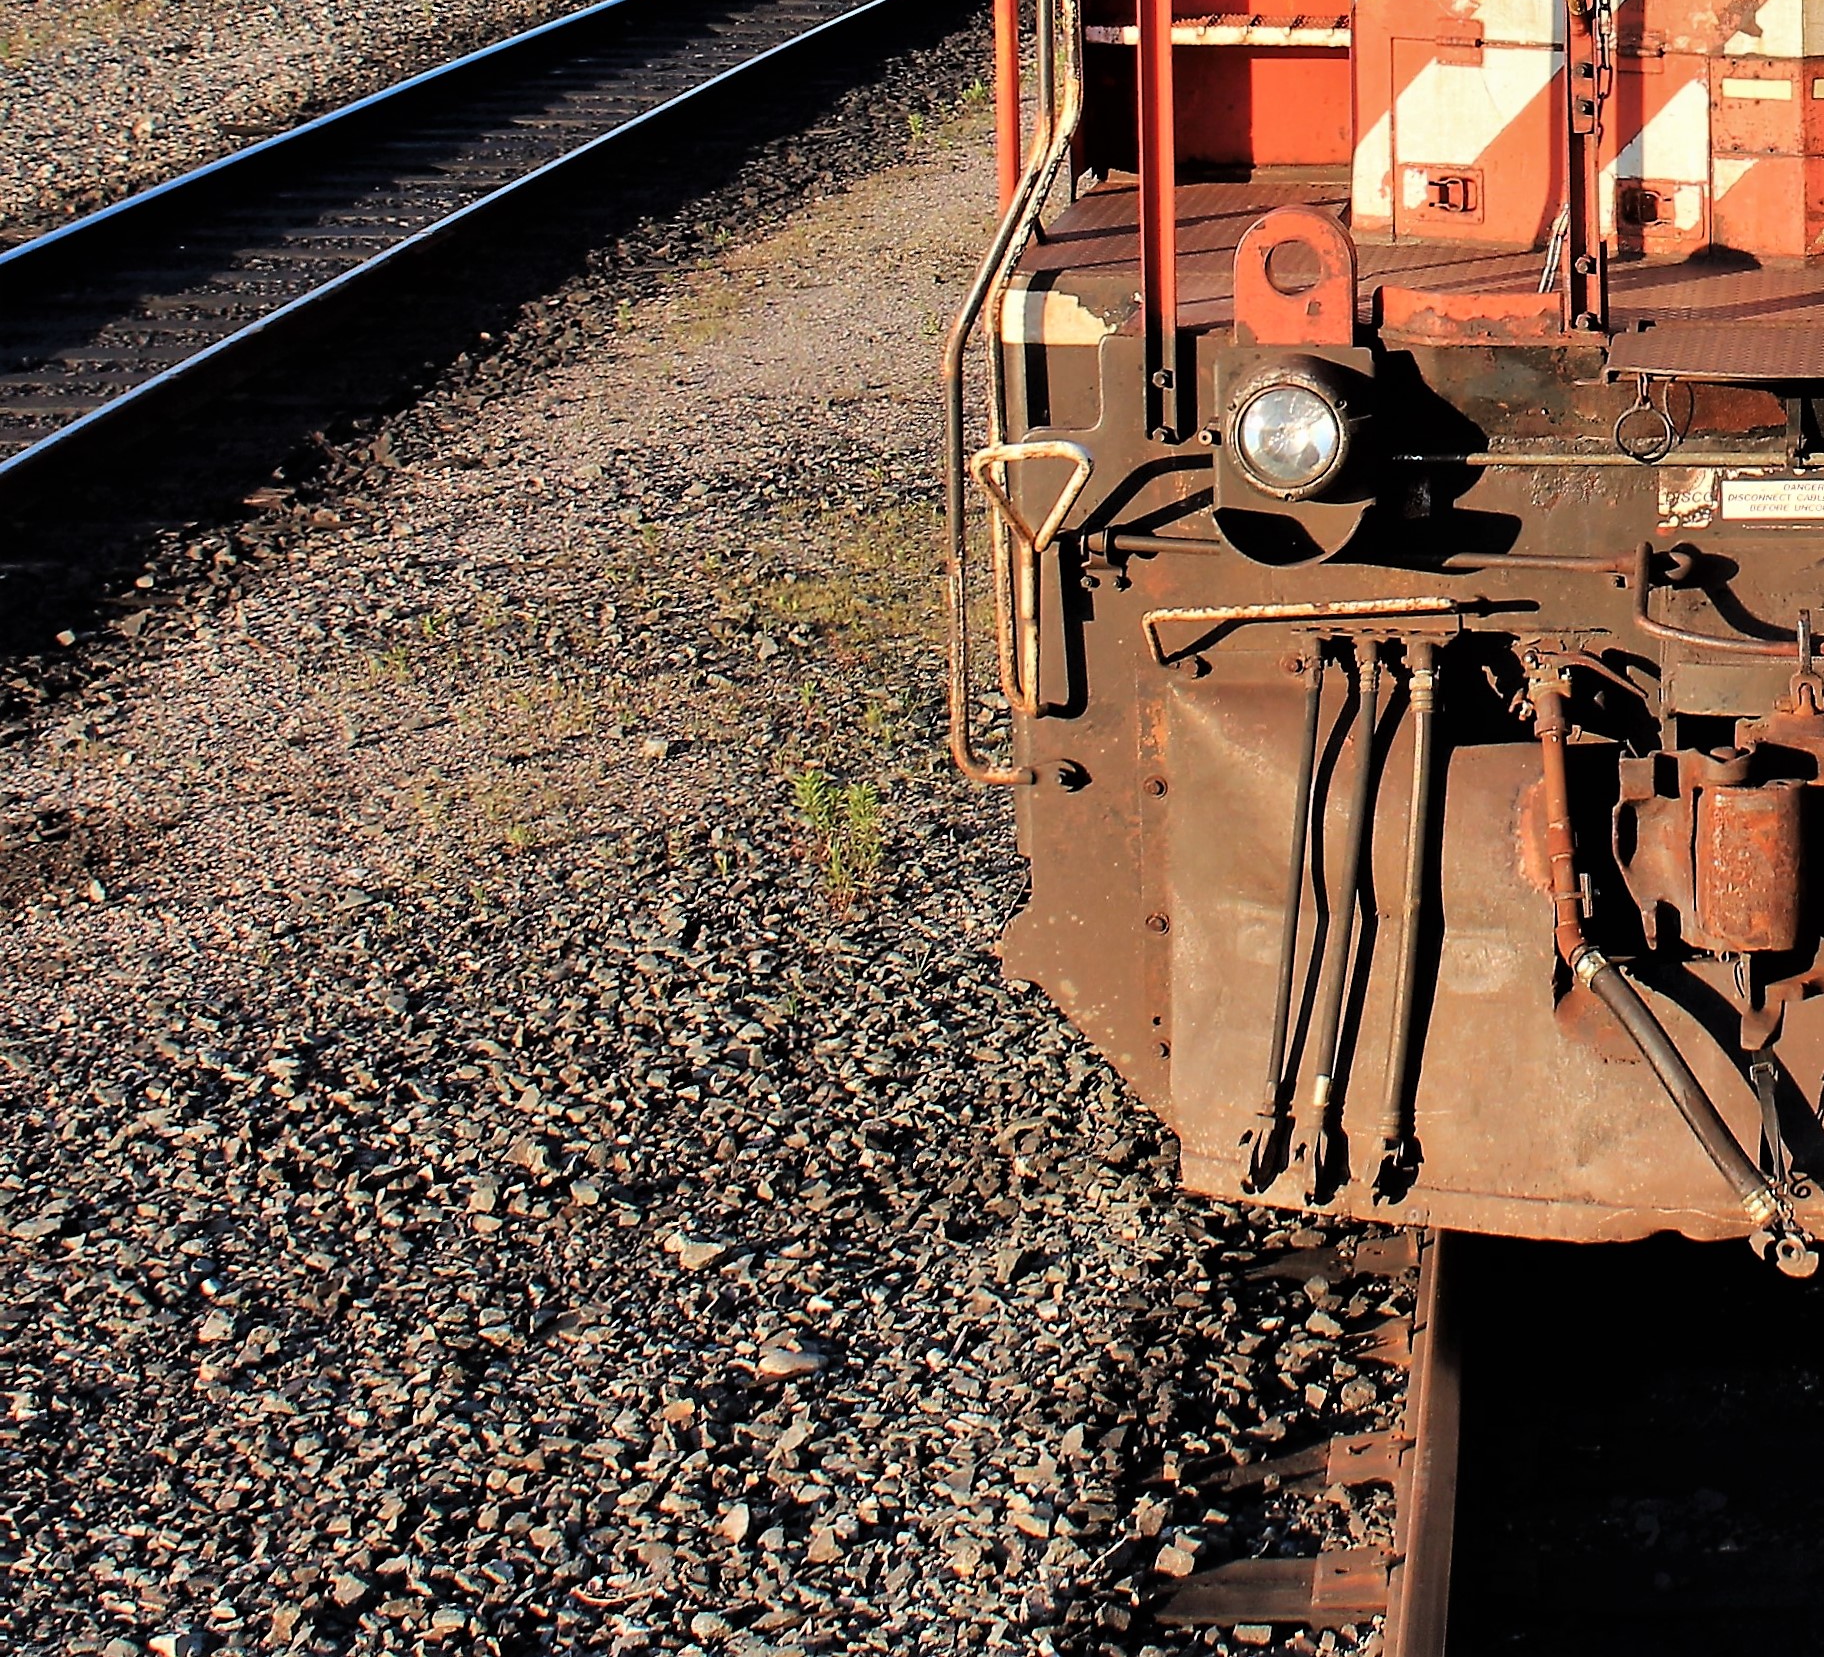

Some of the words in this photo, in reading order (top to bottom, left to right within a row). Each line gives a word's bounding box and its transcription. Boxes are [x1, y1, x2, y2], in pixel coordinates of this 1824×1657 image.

[1783, 483, 1824, 491] DANGER
[1728, 493, 1791, 502] DISCONNECT
[1749, 504, 1789, 512] BEFORE
